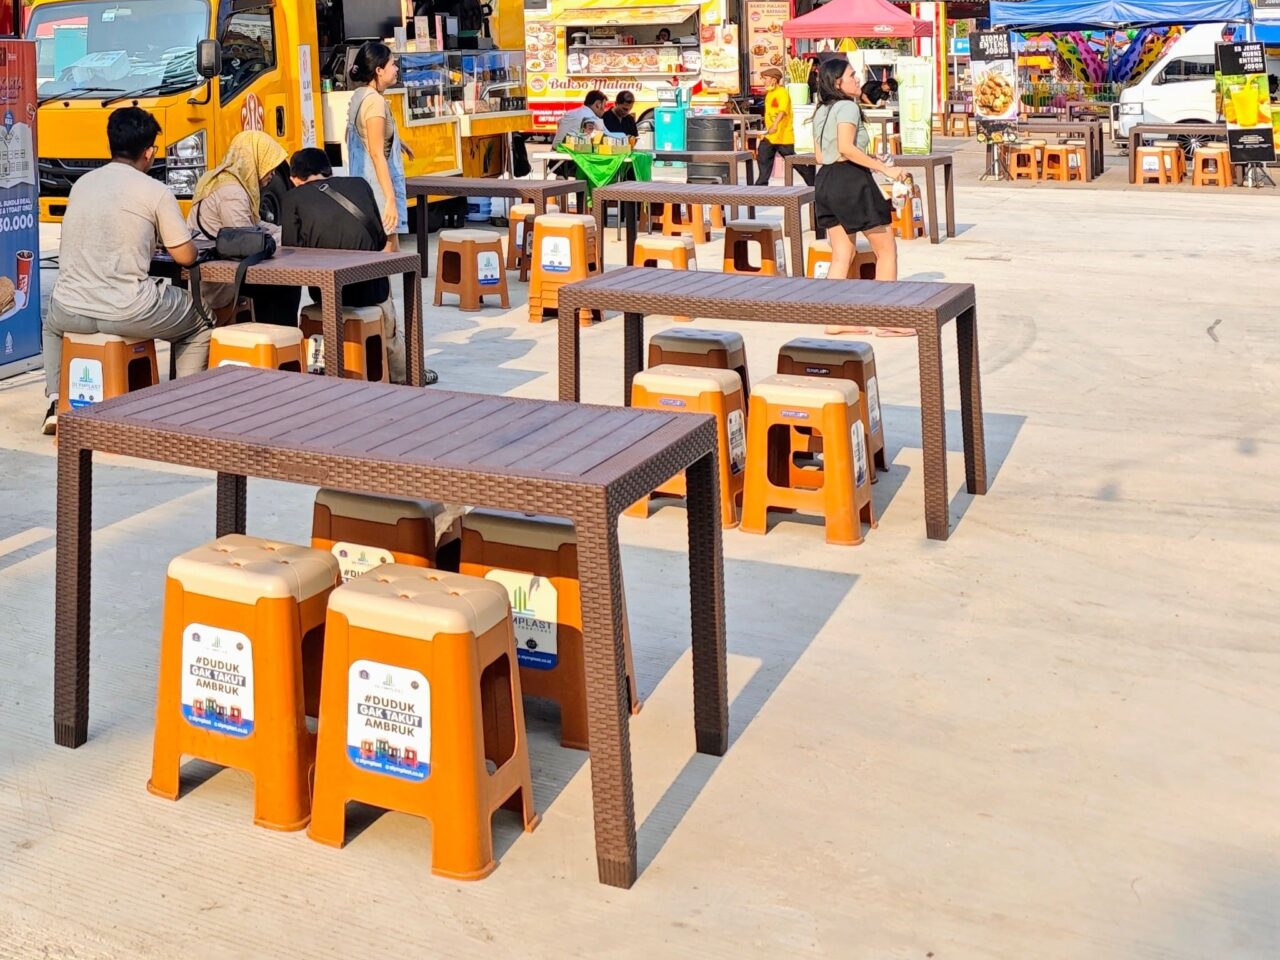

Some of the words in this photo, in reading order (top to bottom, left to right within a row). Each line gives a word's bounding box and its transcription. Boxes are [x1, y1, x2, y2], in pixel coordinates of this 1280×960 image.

[549, 78, 589, 90] Bakso
[591, 78, 643, 91] Malang
[195, 656, 240, 673] #DUDUK
[191, 666, 211, 678] GAK
[214, 671, 245, 686] TAKUT
[195, 678, 240, 696] AMBRUK
[364, 693, 415, 714] #DUDUK
[360, 704, 383, 718] GAK
[385, 710, 421, 727] TAKUT
[364, 718, 415, 738] AMBRUK
